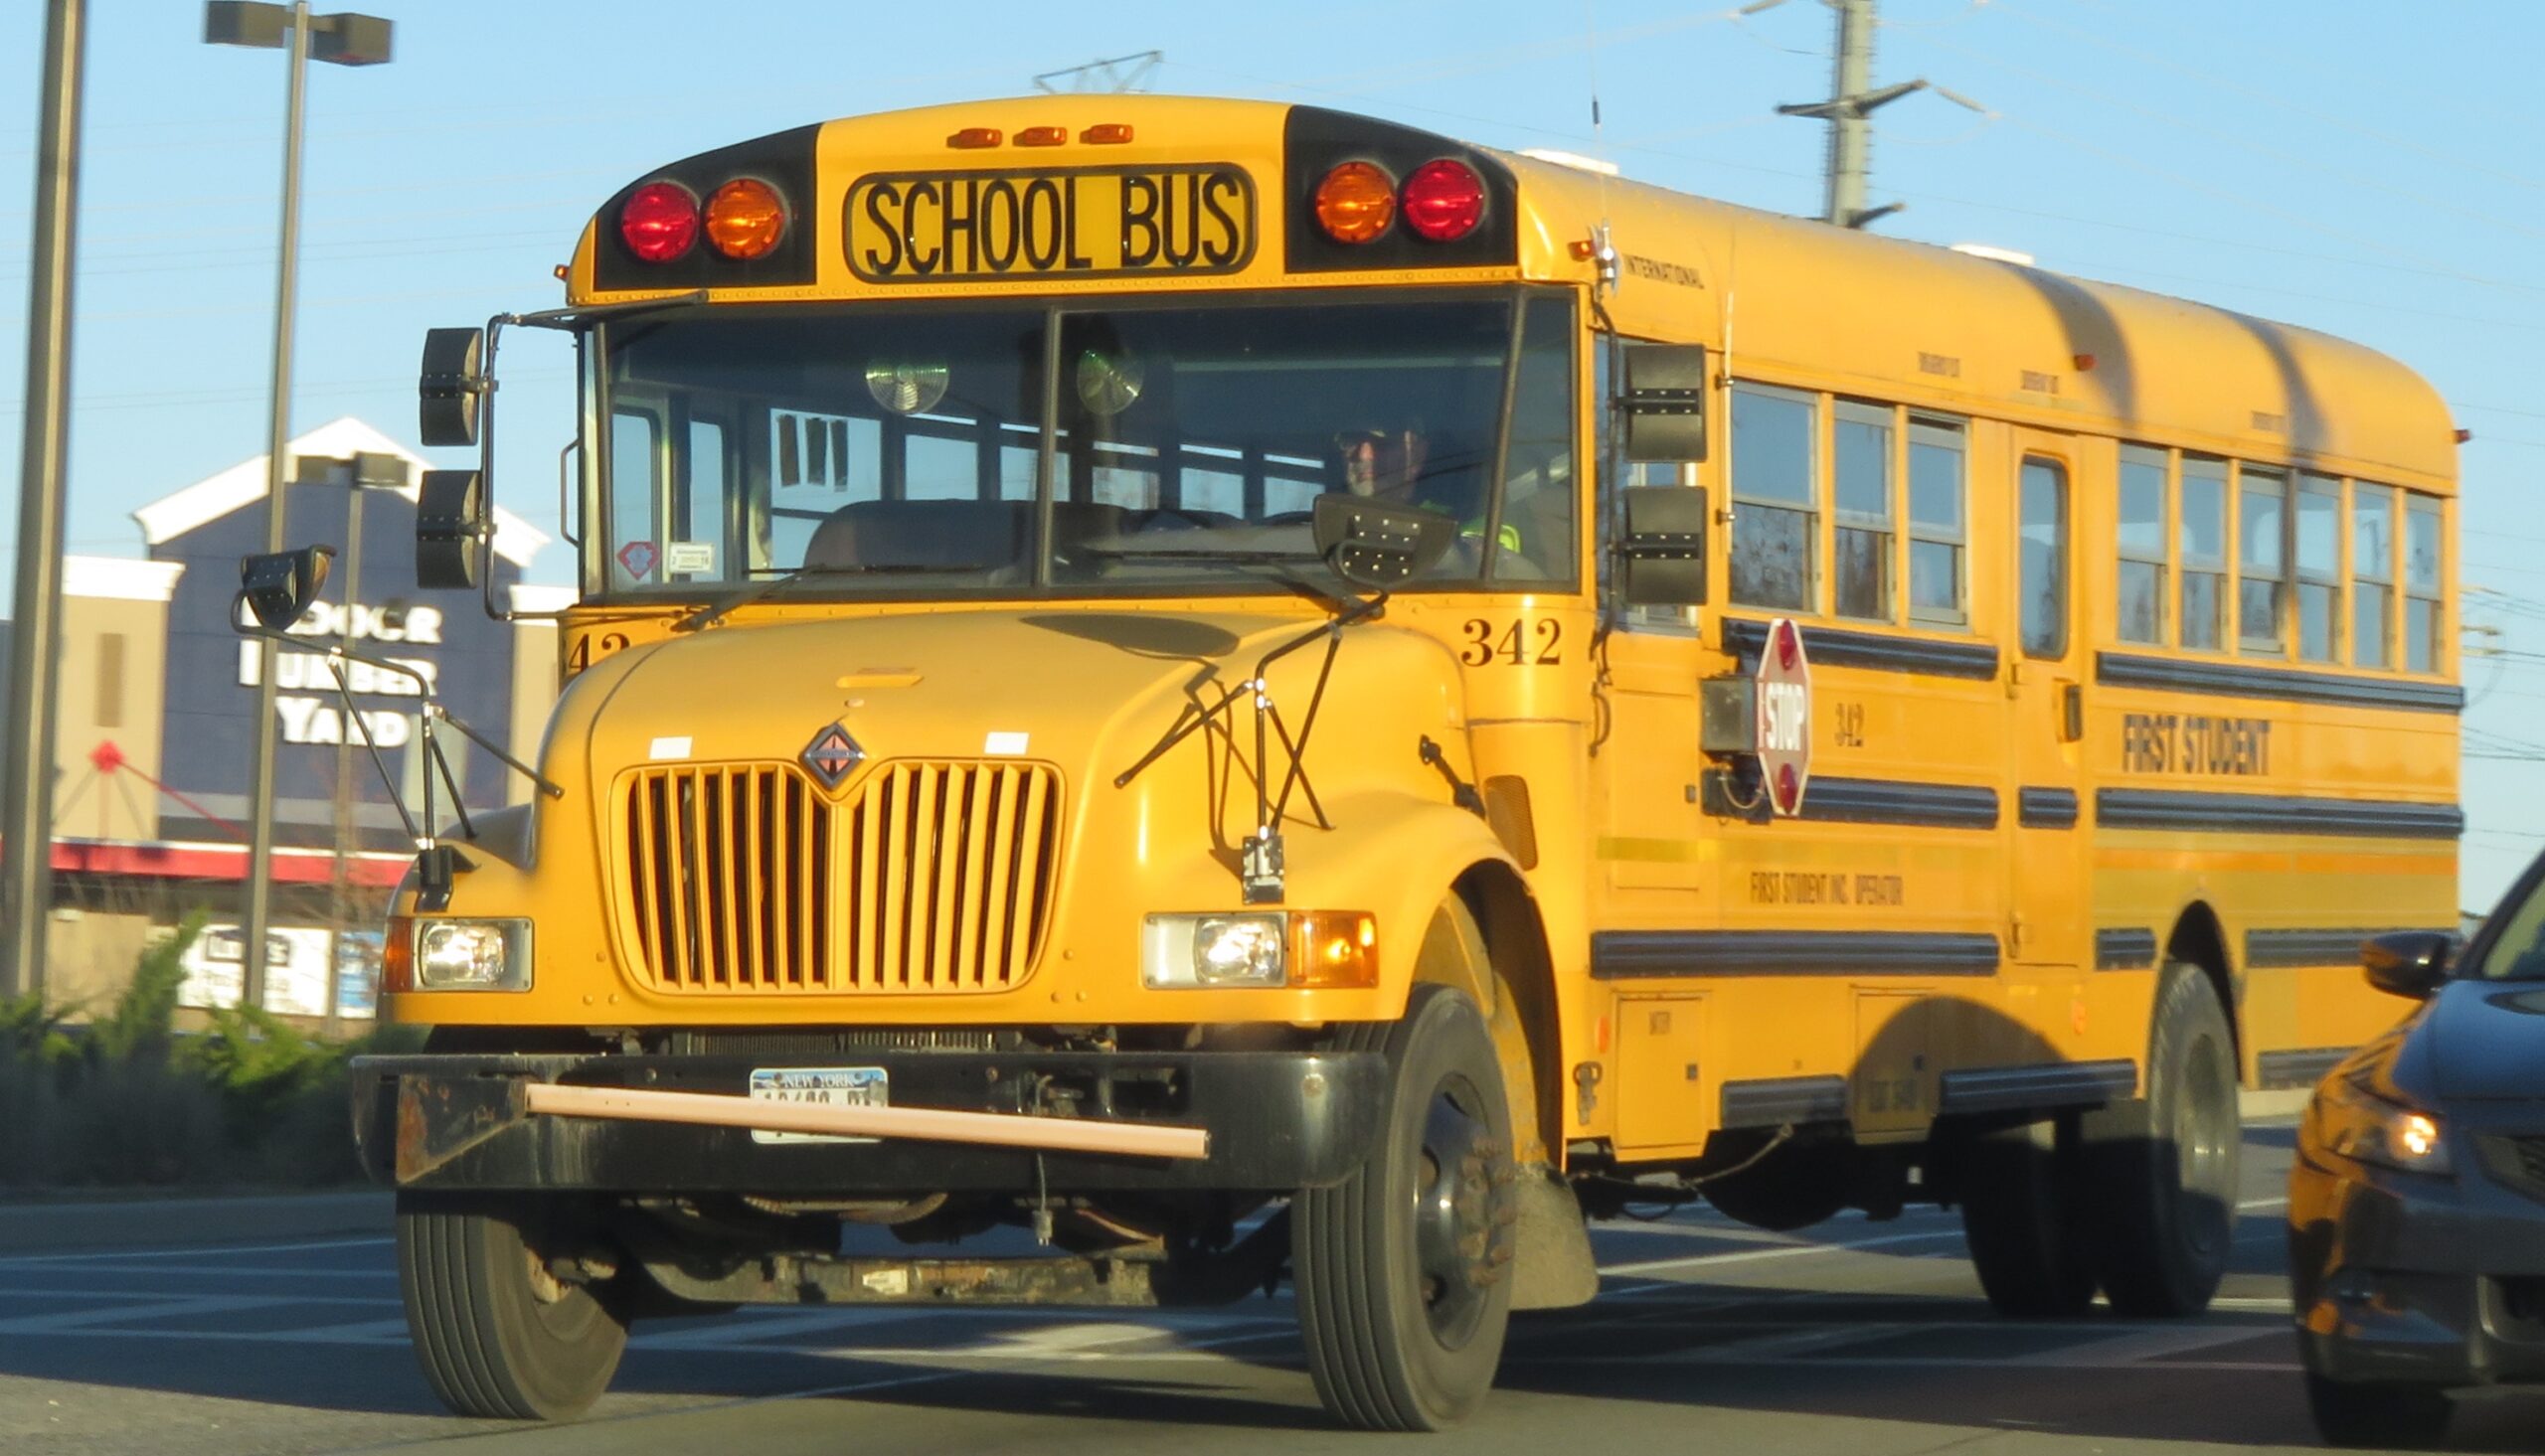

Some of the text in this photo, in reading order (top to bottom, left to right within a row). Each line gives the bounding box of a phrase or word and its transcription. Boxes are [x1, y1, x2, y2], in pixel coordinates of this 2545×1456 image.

[866, 173, 1240, 275] SCHOOL BUS
[1621, 252, 1705, 290] INTERNATIONAL
[1460, 618, 1561, 667] 342
[274, 697, 412, 747] YARD
[1765, 682, 1805, 751] STOP
[1834, 703, 1865, 747] 342
[2122, 714, 2271, 776] FIRST STUDENT
[1750, 872, 1781, 903] FIRST
[1782, 873, 1827, 904] STUDENT
[1854, 875, 1903, 905] OPERATOR
[784, 1072, 855, 1088] NEW YORK
